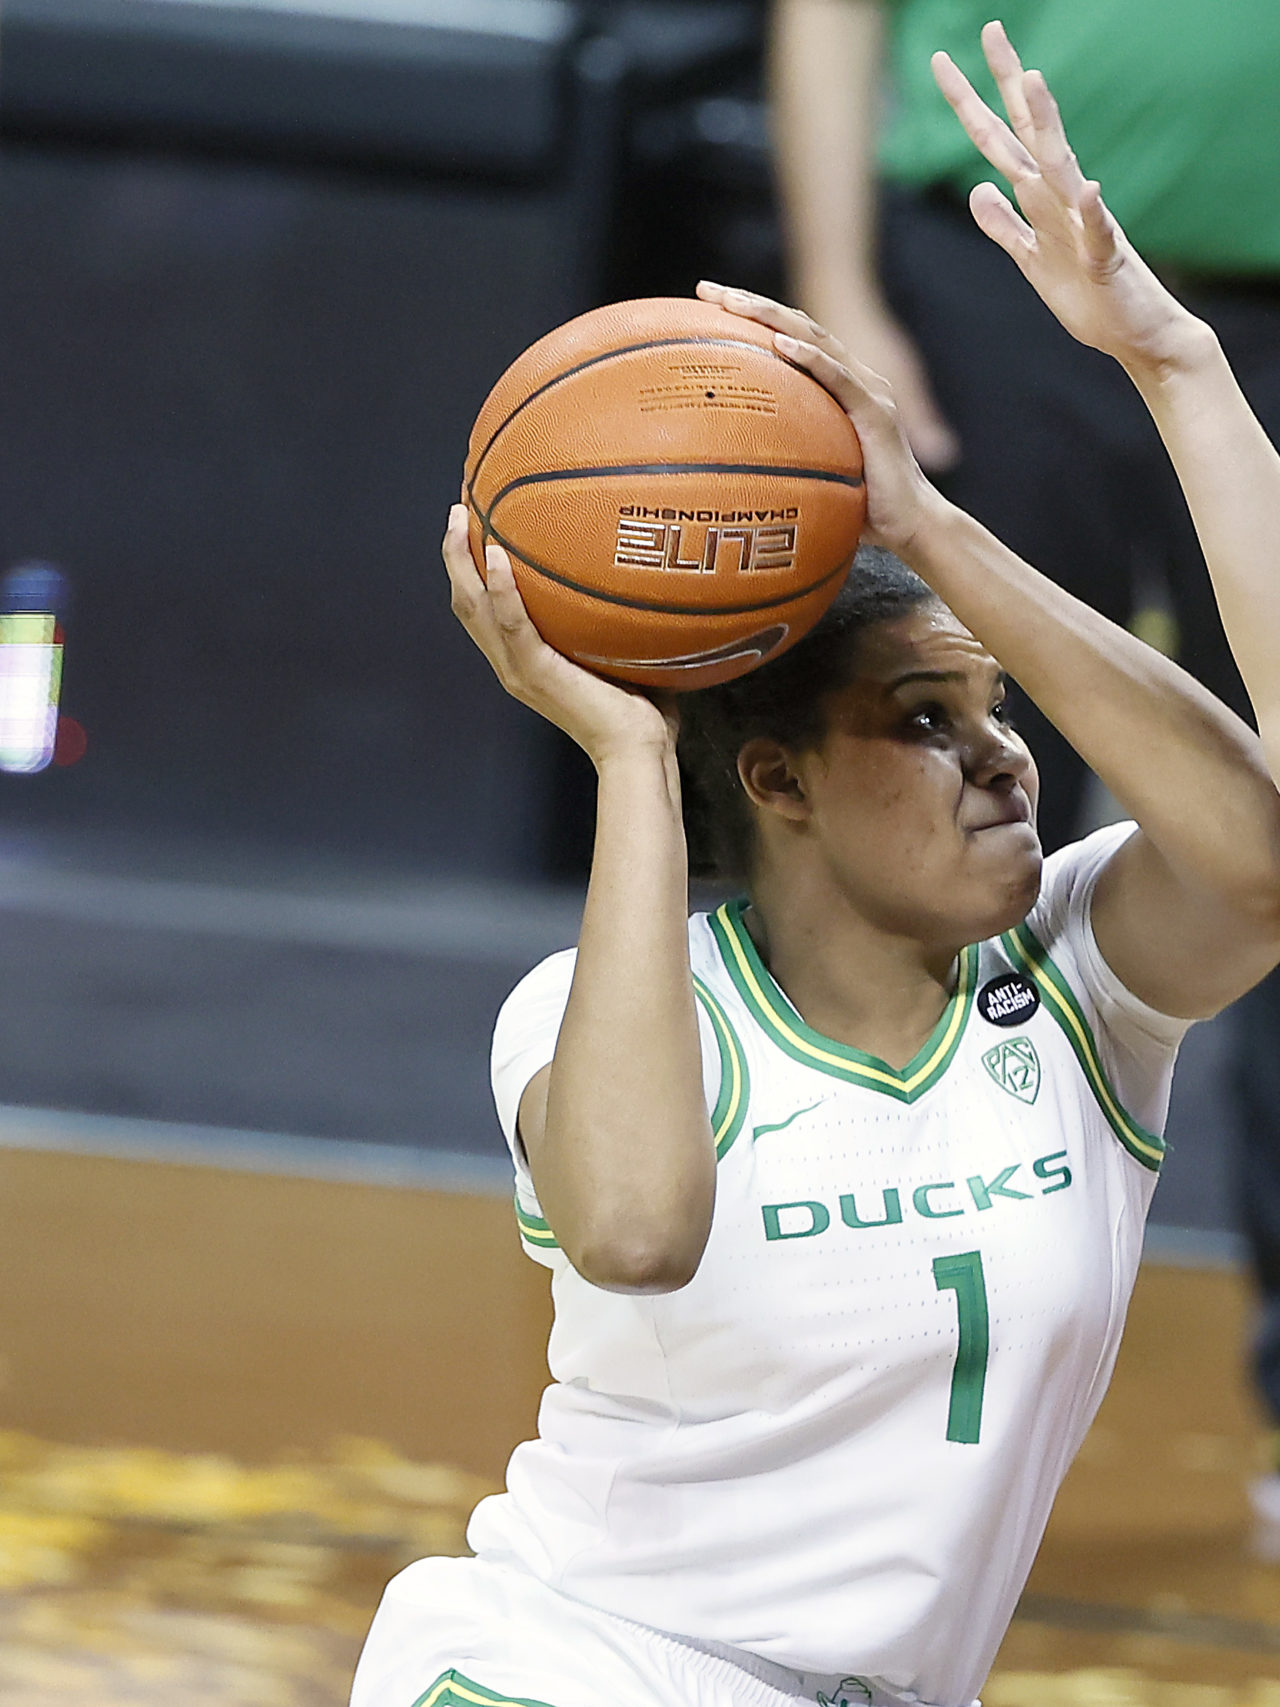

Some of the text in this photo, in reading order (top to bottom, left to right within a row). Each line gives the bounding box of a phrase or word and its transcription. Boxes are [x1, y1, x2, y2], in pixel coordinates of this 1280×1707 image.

[619, 505, 798, 523] CHAMPIONSHIP
[614, 519, 798, 575] ELITE
[986, 982, 1023, 1006] ANTI-
[986, 988, 1036, 1021] RACISM
[761, 1150, 1072, 1241] DUCKS
[931, 1250, 989, 1444] 1
